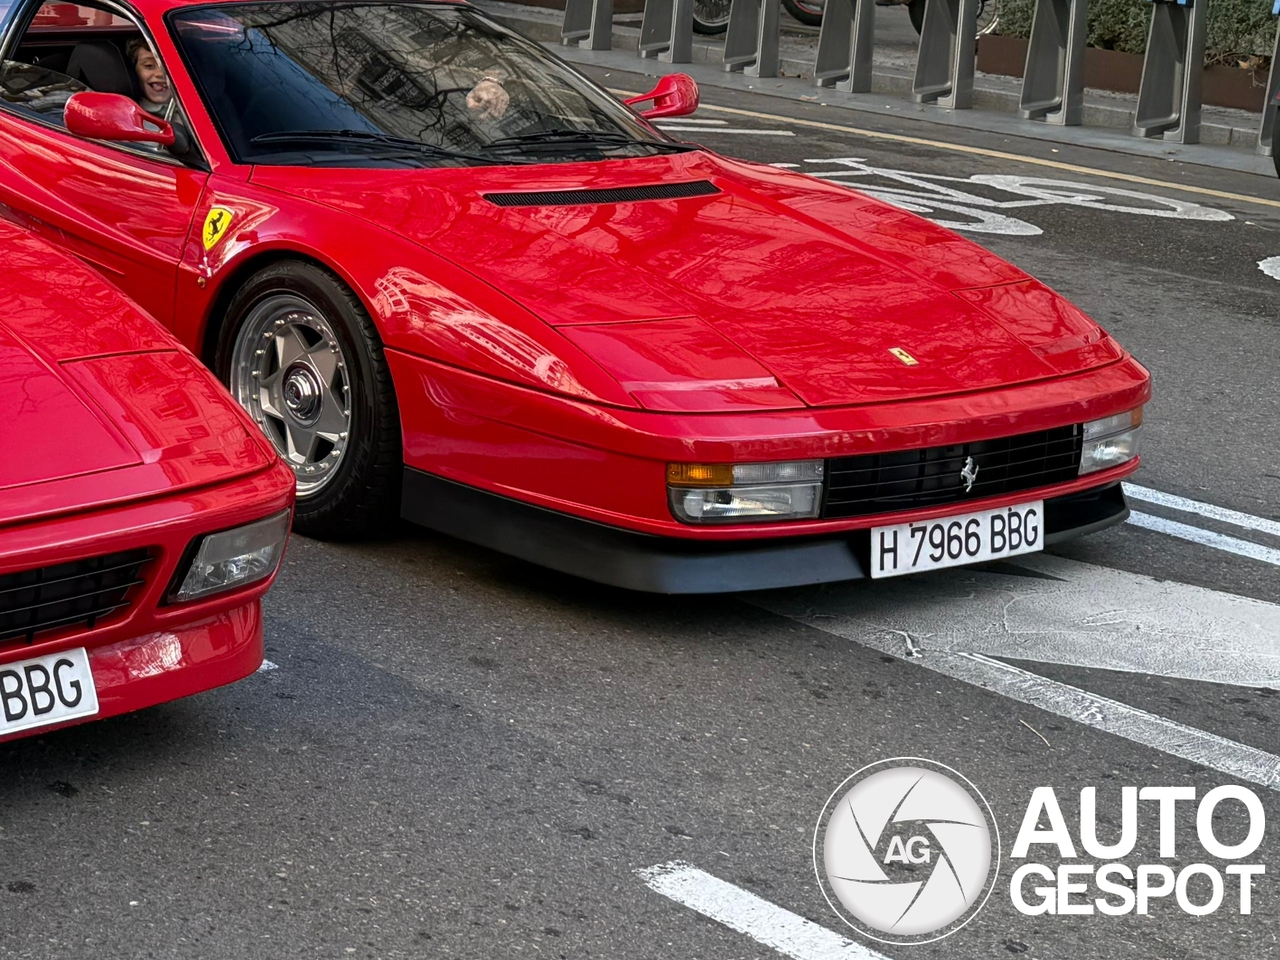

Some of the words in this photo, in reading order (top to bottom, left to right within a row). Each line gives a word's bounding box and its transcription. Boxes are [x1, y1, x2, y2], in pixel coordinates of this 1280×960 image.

[879, 530, 898, 572] H
[910, 518, 981, 568] 7966
[990, 508, 1039, 554] BBG
